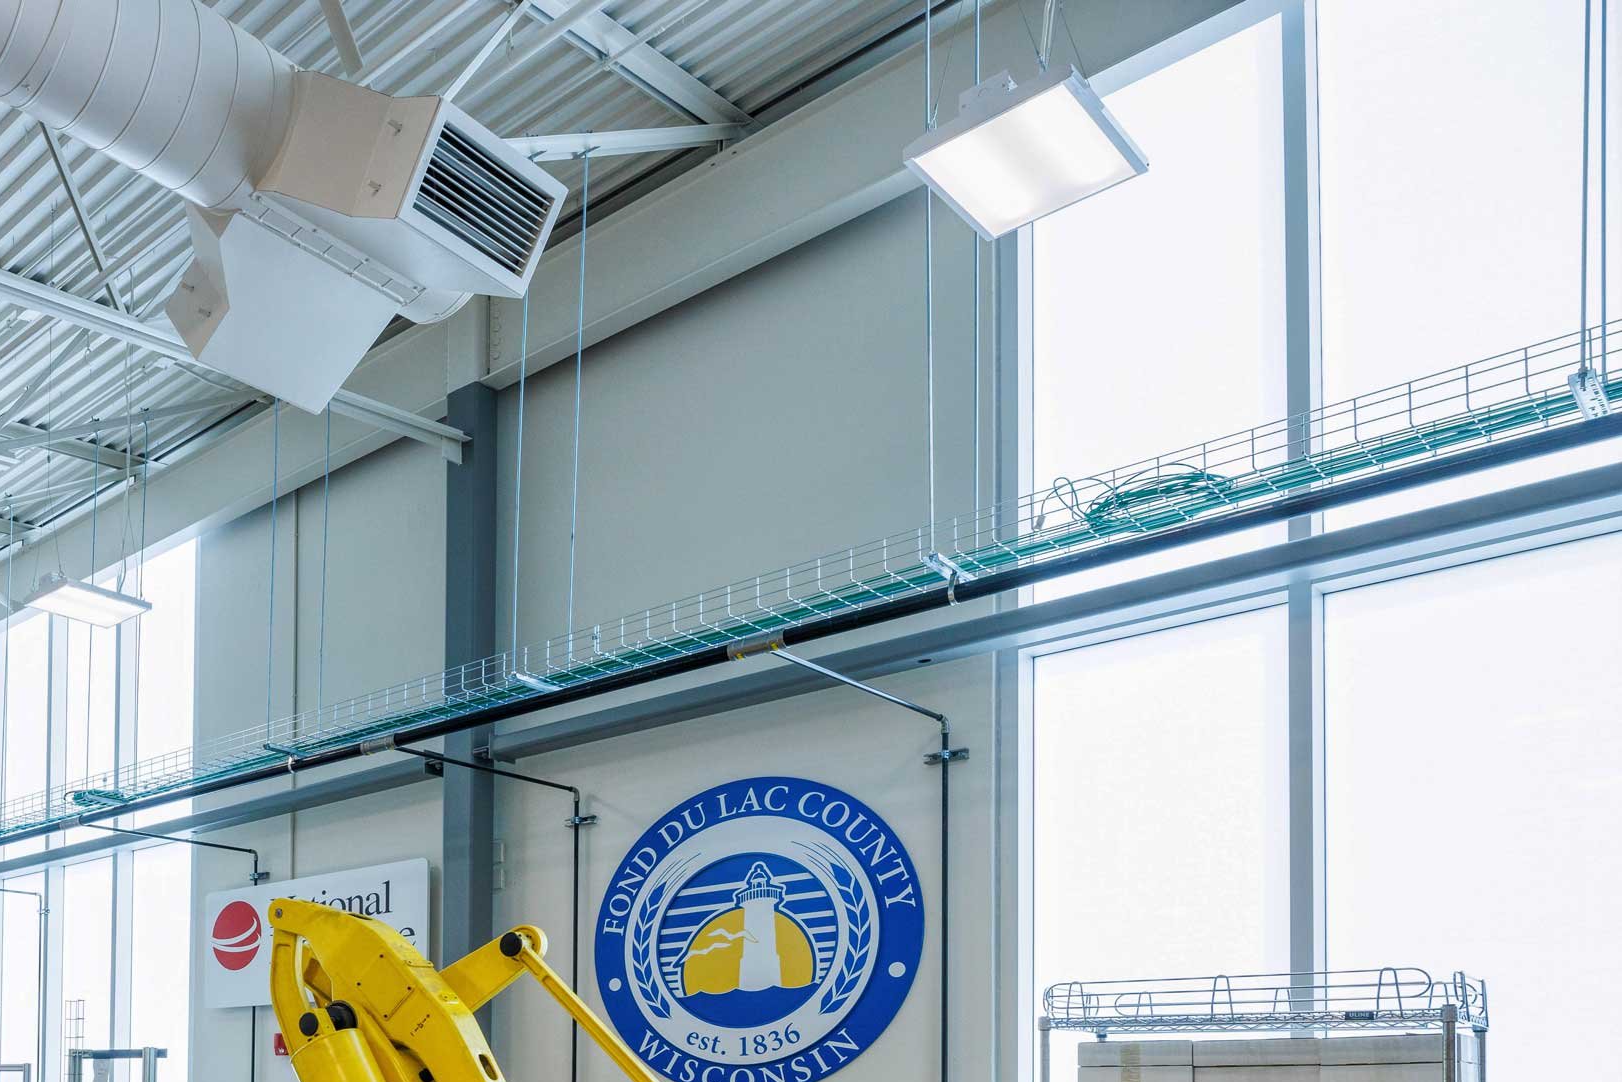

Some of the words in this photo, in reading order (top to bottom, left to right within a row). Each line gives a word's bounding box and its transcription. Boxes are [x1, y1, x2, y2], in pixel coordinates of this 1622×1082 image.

[602, 846, 657, 937] FOND
[657, 804, 707, 849] DU
[716, 785, 789, 819] LAC
[797, 790, 916, 909] COUNTY
[686, 1030, 726, 1056] est.
[739, 1022, 801, 1057] 1836
